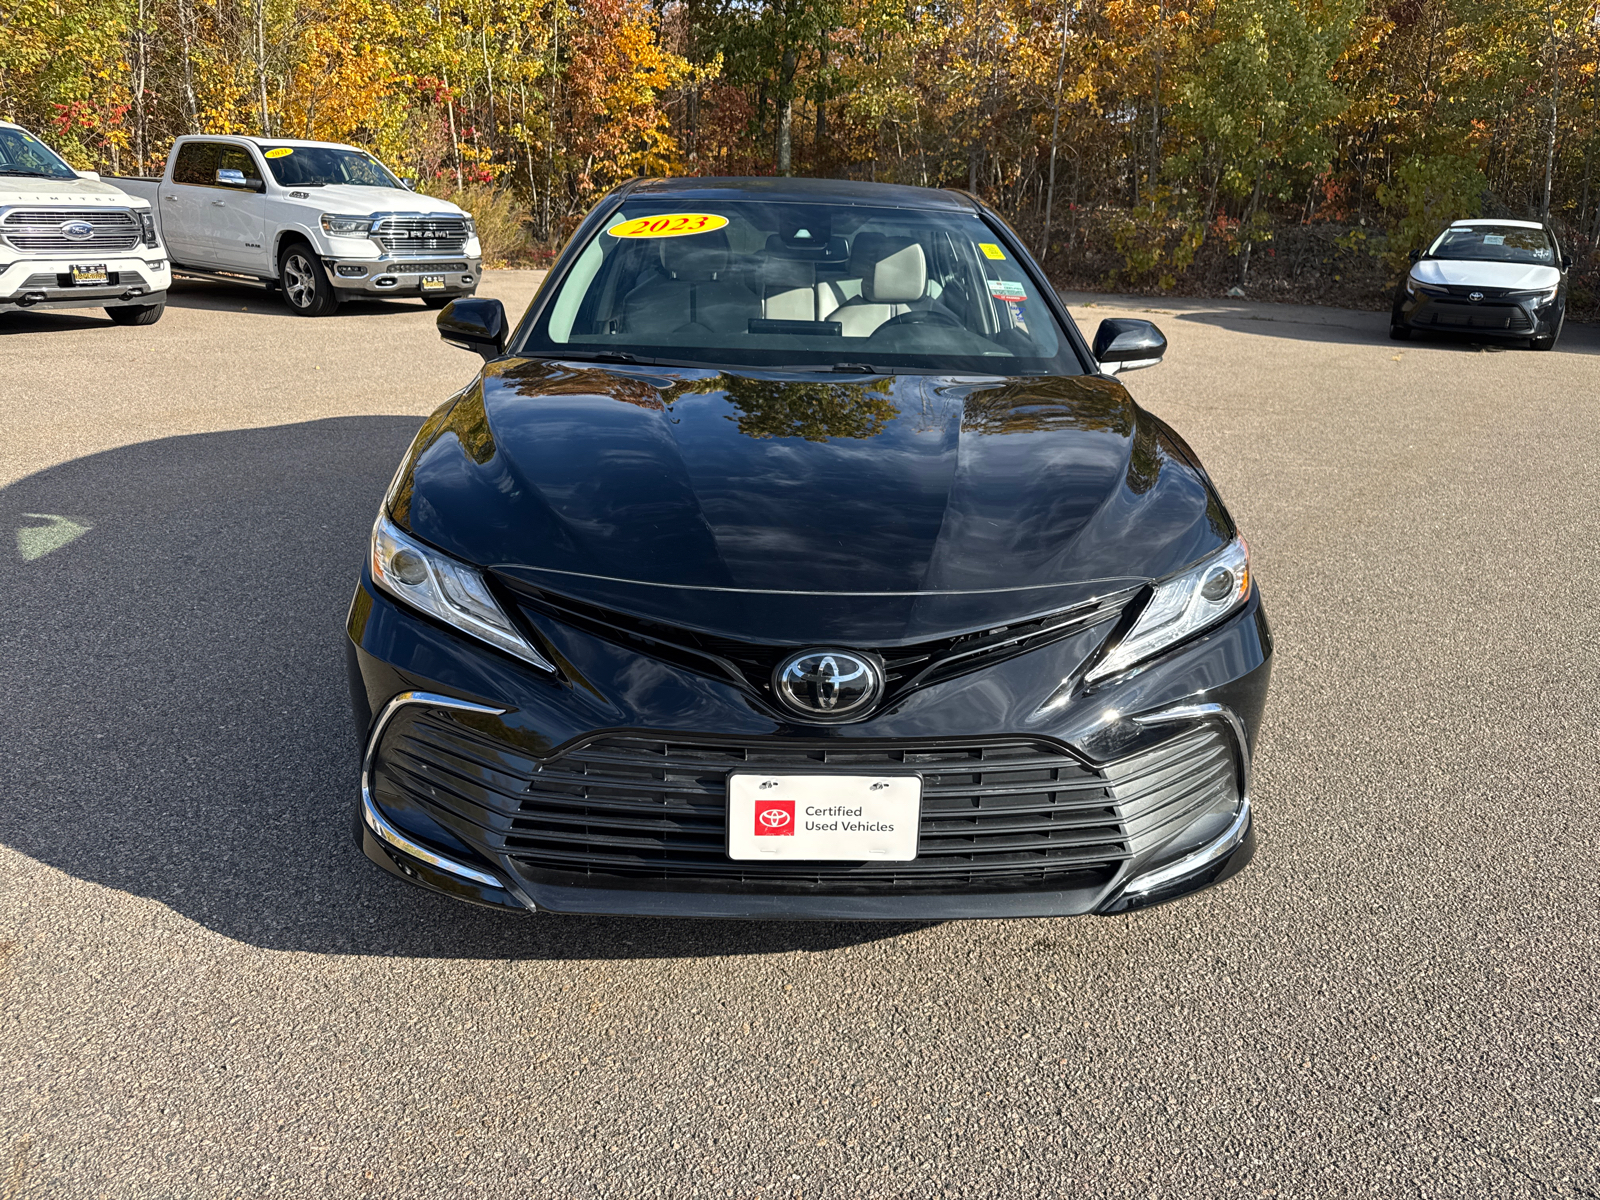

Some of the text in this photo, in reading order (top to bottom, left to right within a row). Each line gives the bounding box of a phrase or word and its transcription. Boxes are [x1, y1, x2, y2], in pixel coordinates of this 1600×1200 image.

[270, 149, 288, 157] 2021
[71, 226, 88, 234] Ford
[628, 216, 709, 235] 2023
[410, 230, 446, 238] RAM
[805, 806, 862, 817] Certified
[805, 821, 895, 832] Used Vehicles
